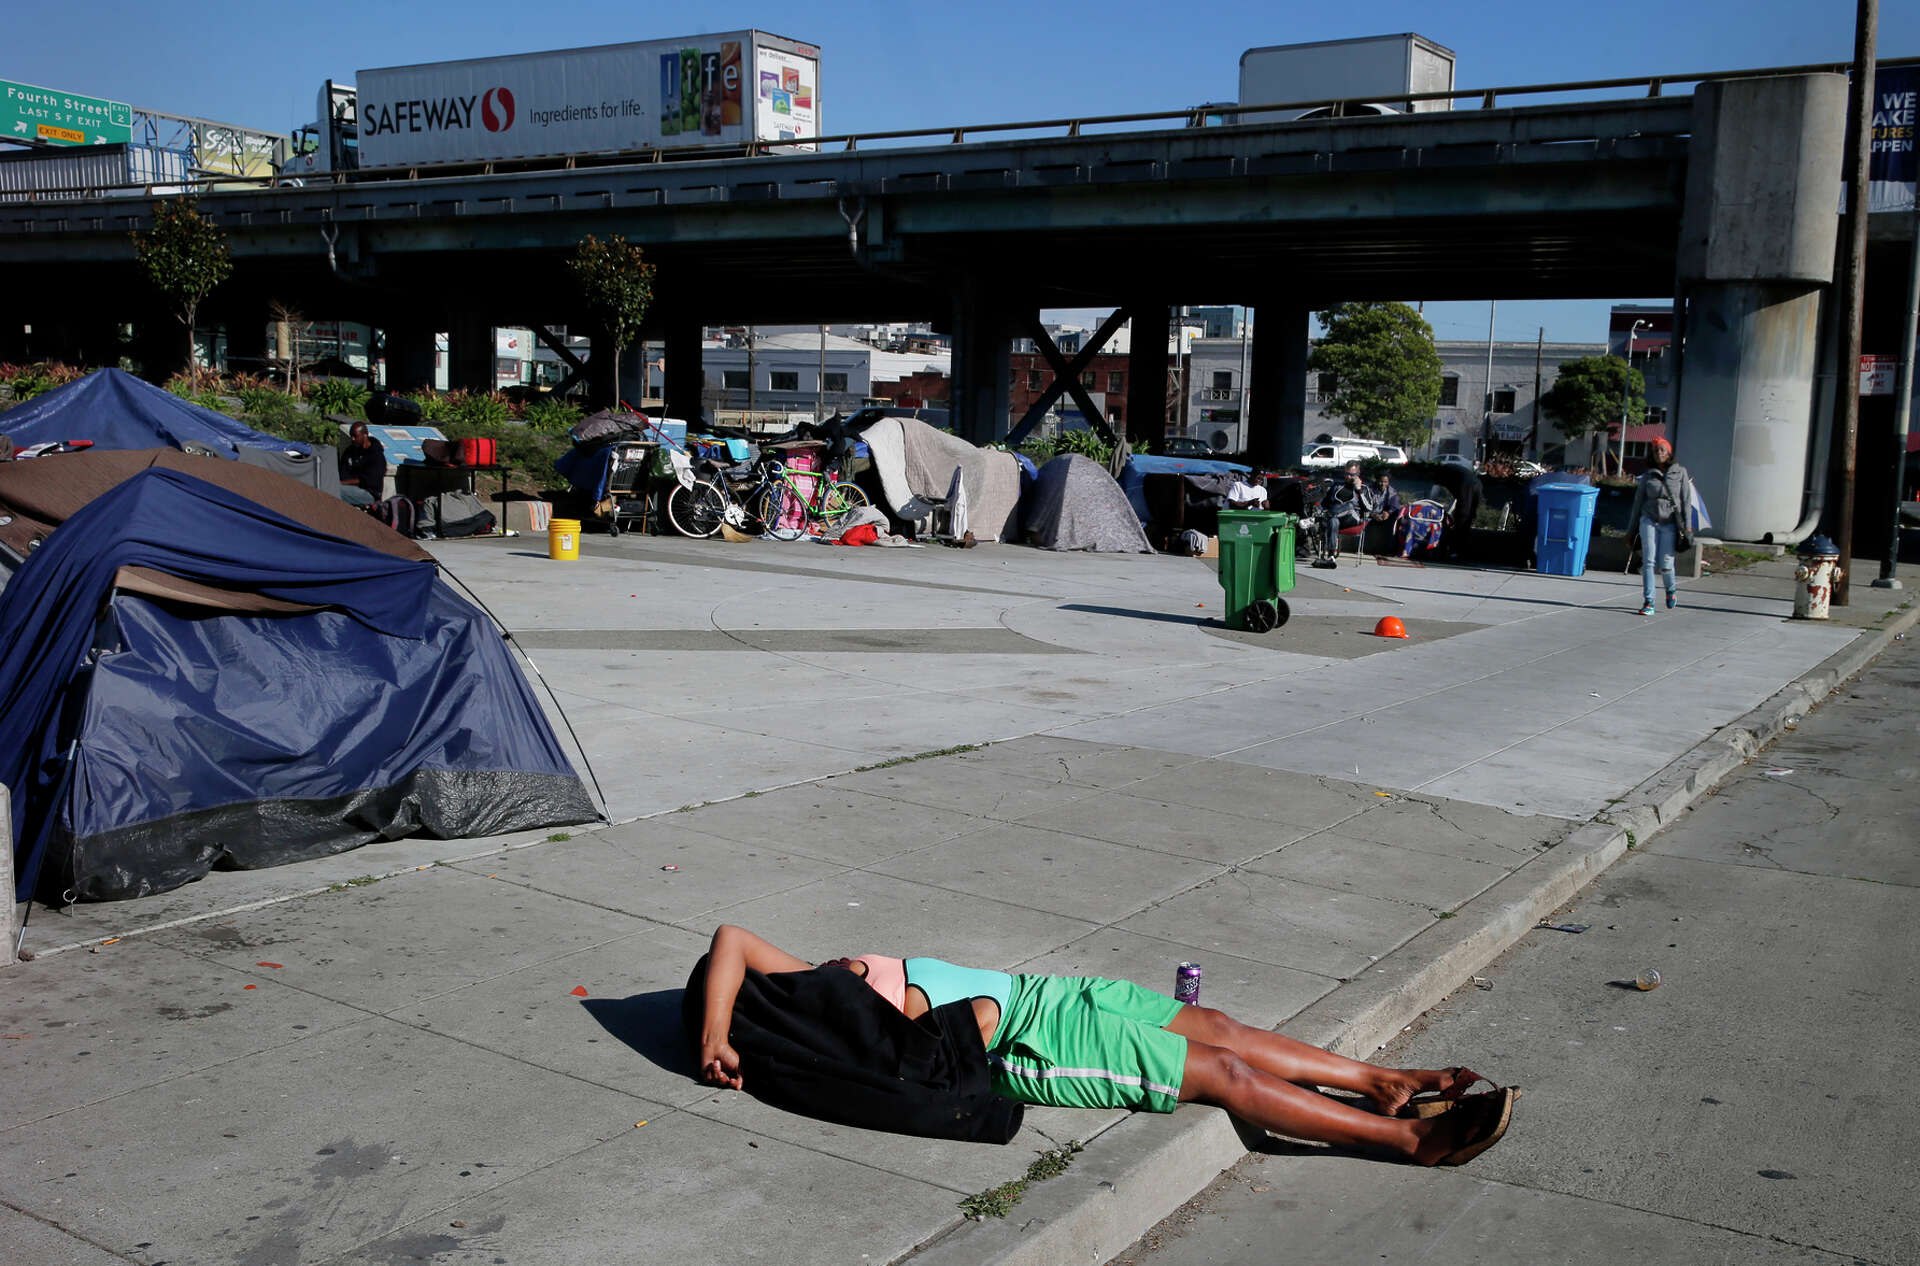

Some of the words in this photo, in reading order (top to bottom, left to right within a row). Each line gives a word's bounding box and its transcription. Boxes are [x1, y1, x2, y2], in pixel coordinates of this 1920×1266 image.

[667, 55, 738, 95] life
[7, 87, 58, 107] Fourth
[64, 98, 109, 117] Street
[112, 104, 129, 113] EXIT
[1882, 92, 1917, 109] WE
[19, 106, 49, 119] LAST
[55, 112, 61, 121] S
[66, 114, 72, 122] F
[78, 116, 104, 128] EXIT
[118, 114, 124, 122] 2
[364, 95, 477, 137] SAFEWAY
[529, 104, 599, 127] Ingredients
[600, 101, 618, 118] for
[621, 98, 645, 117] life.
[1872, 110, 1914, 126] AKE
[39, 126, 57, 135] EXIT
[61, 130, 83, 140] ONLY
[1871, 127, 1914, 139] TURES
[1871, 140, 1913, 152] PPEN
[1861, 362, 1871, 370] NO
